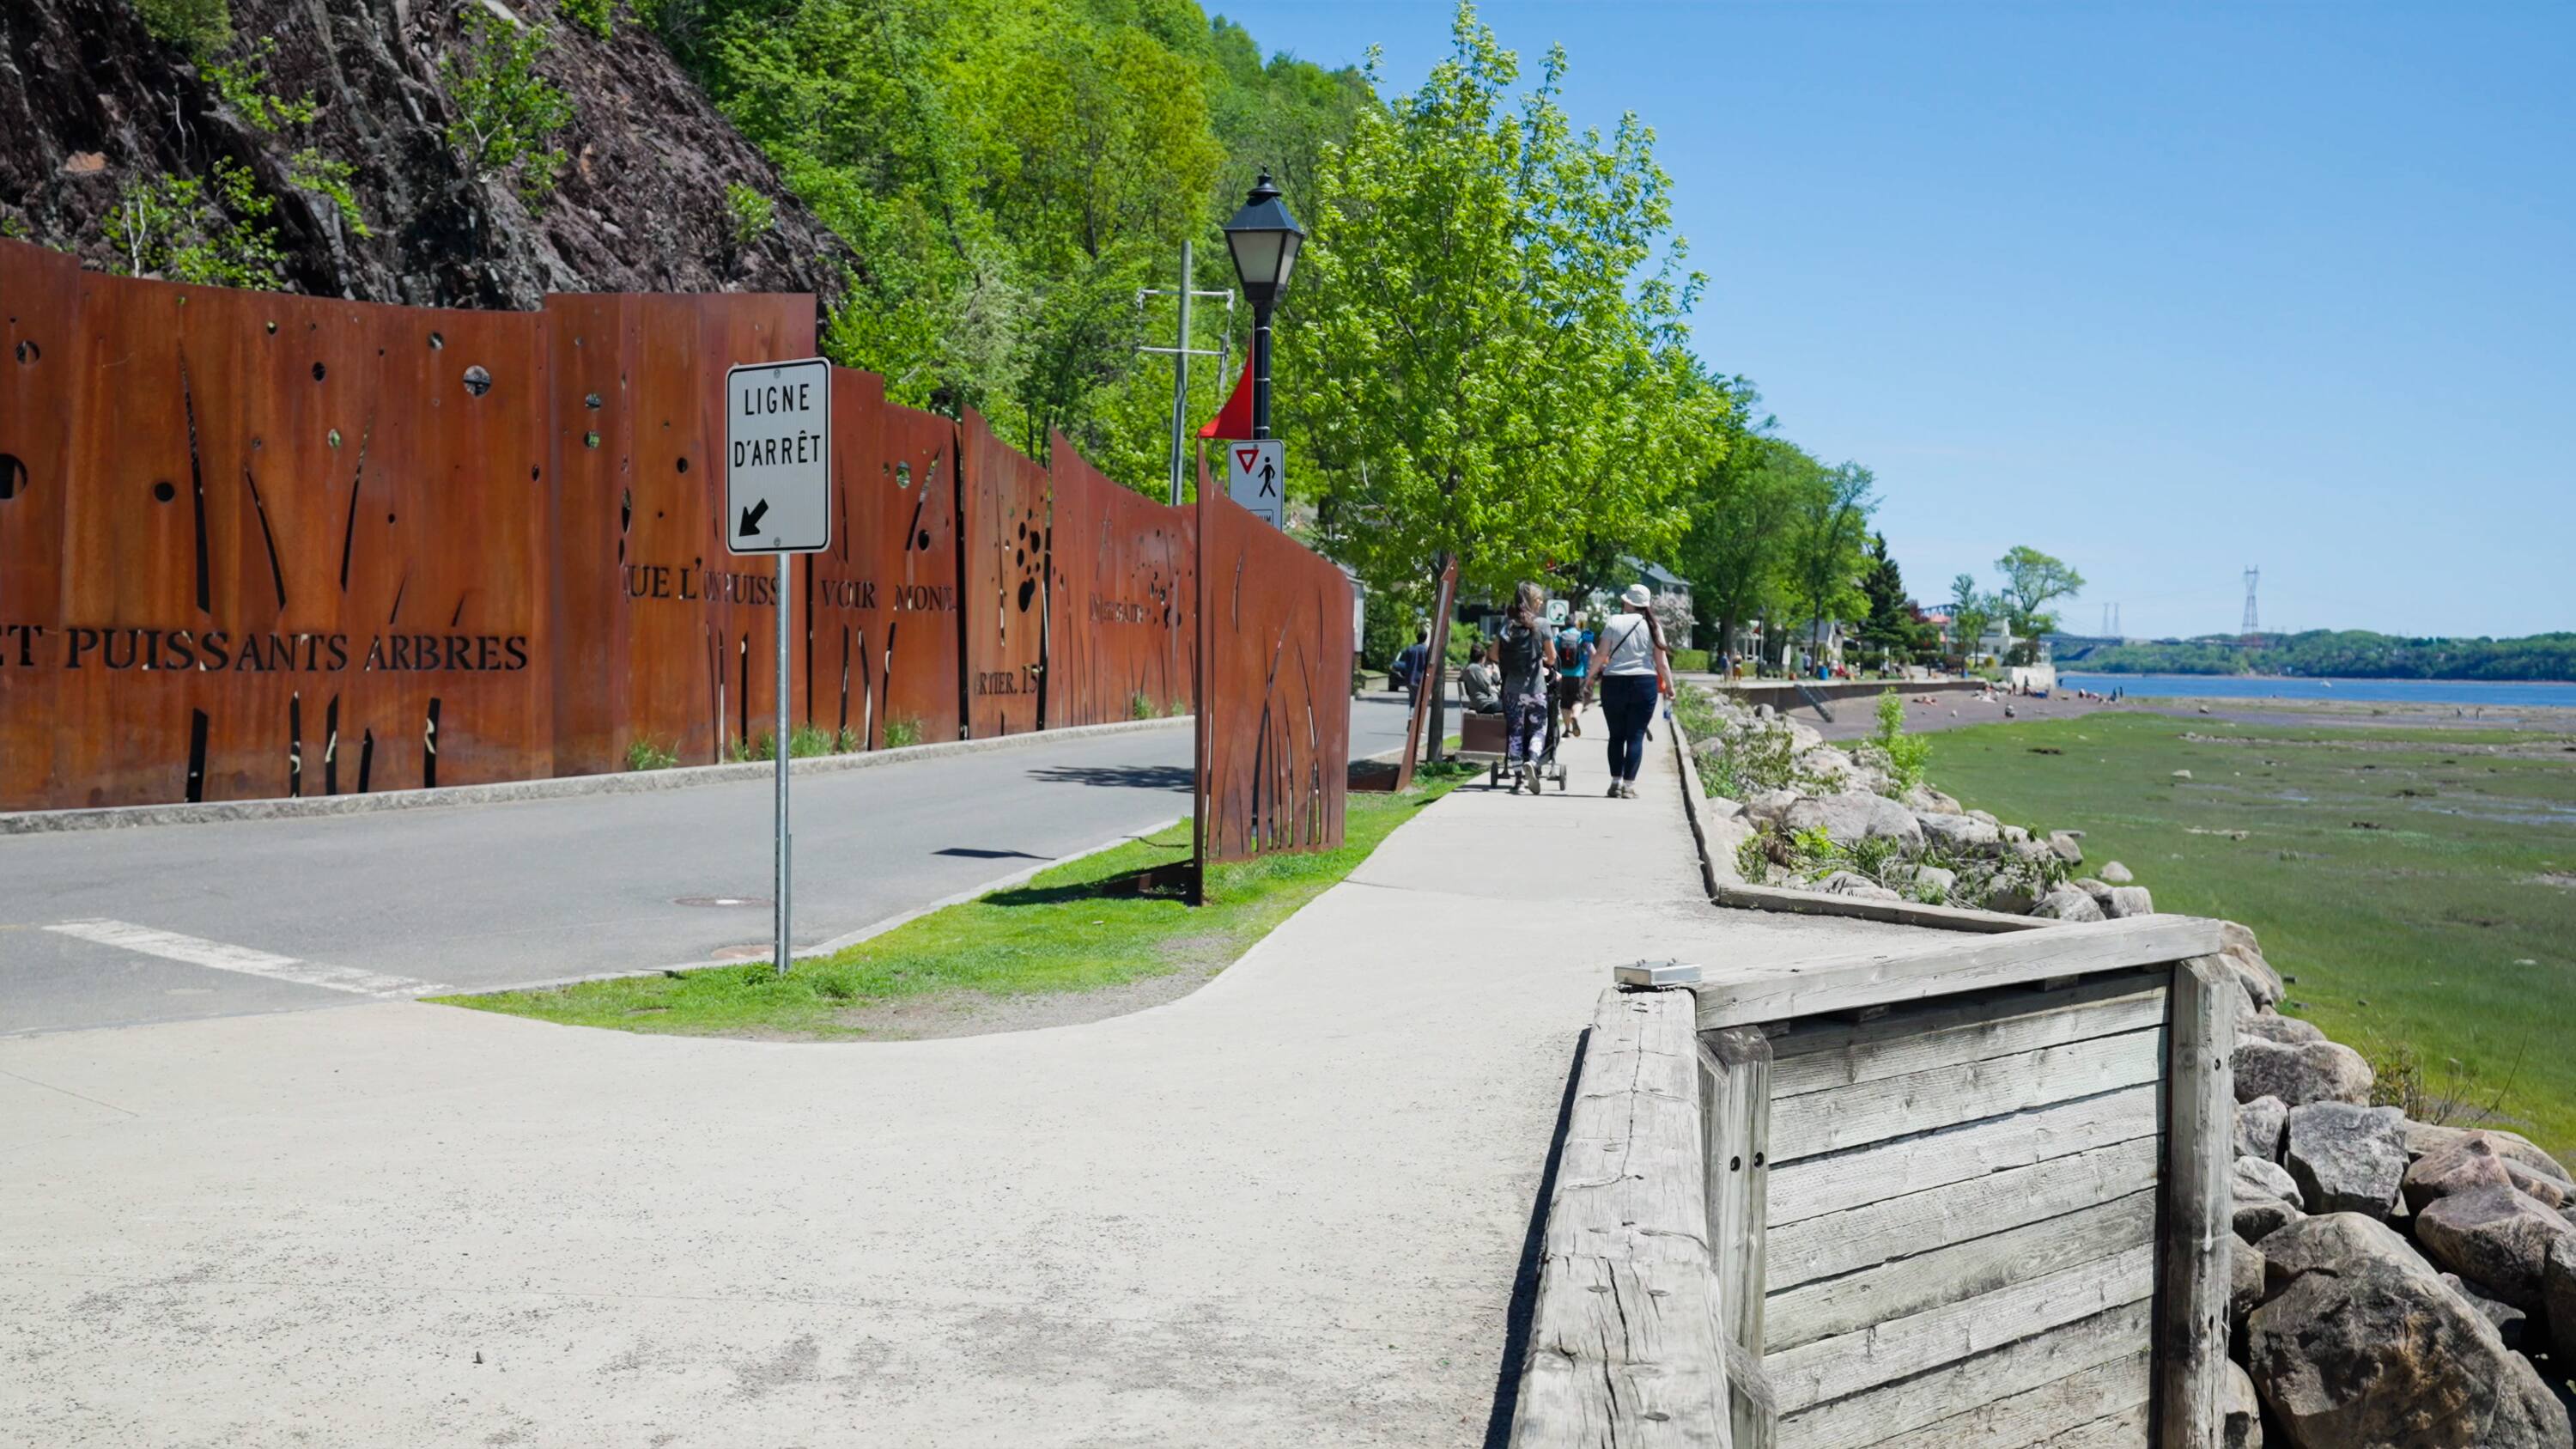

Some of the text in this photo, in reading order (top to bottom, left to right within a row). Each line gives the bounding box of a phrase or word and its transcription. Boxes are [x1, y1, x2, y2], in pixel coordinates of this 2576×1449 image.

[744, 383, 810, 416] LIGNE
[734, 429, 821, 468] D'ARRÊT
[821, 579, 876, 609] VOIR
[64, 627, 349, 672] PUISSANTS
[364, 634, 528, 671] ARBRES
